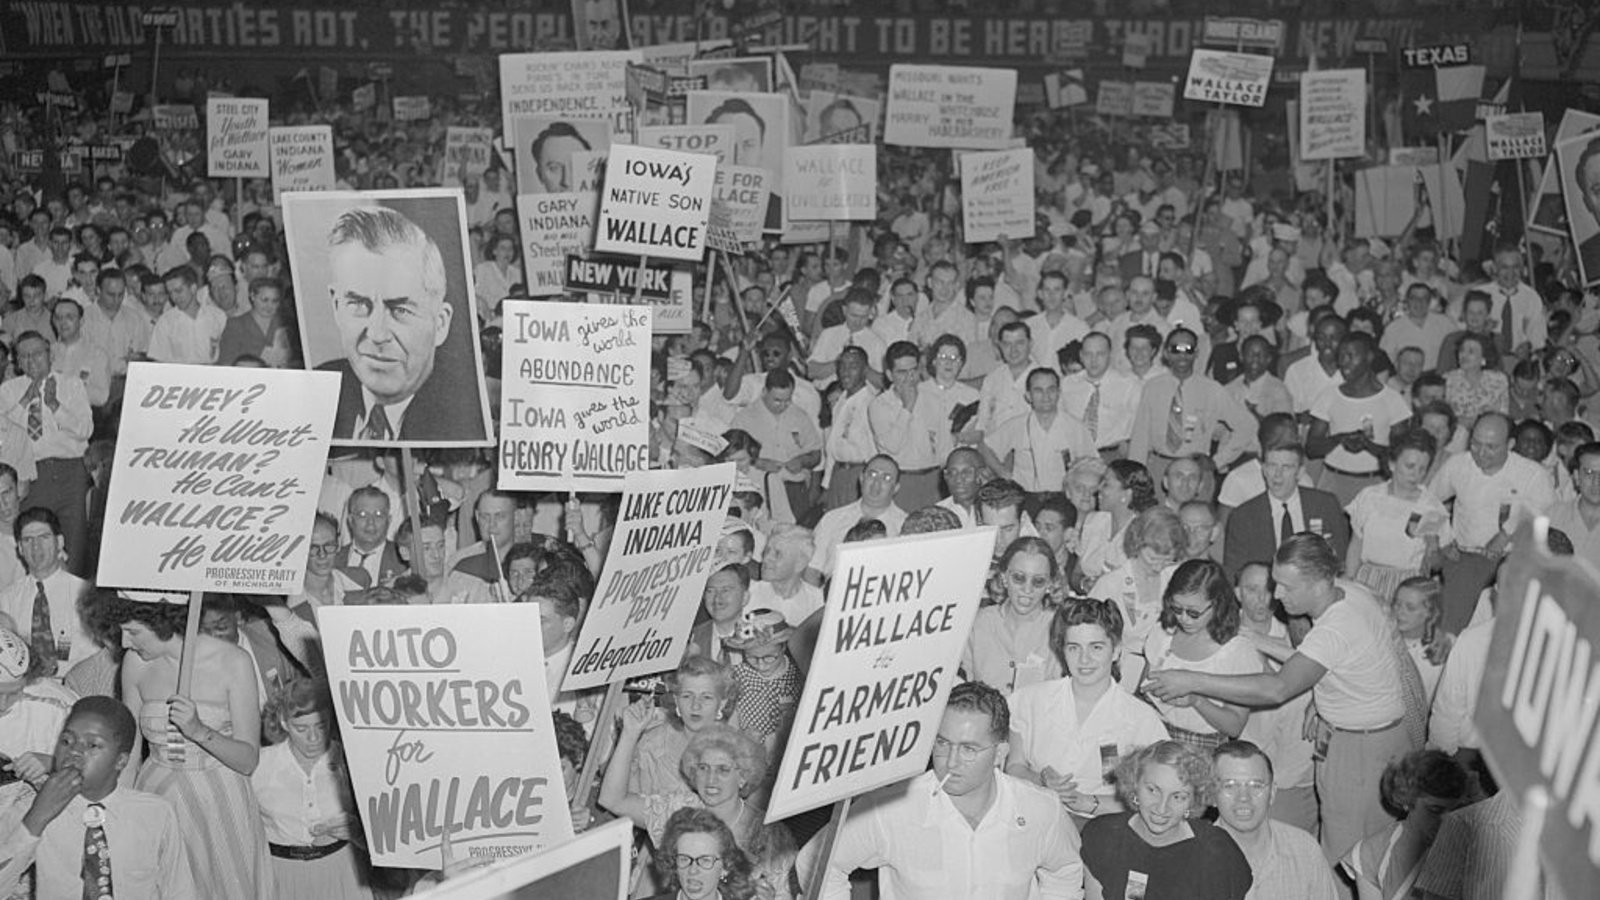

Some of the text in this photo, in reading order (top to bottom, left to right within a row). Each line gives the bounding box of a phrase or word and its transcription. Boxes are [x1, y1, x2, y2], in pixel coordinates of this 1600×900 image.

[150, 2, 280, 46] ARTIES
[467, 12, 568, 49] PEOPL
[632, 14, 693, 47] AVE
[875, 18, 916, 53] TO
[930, 18, 972, 54] BE
[1404, 45, 1468, 66] TEXAS
[1190, 77, 1263, 94] WALLACE
[1204, 89, 1262, 104] TAYLOR
[223, 149, 254, 160] GARY
[276, 144, 326, 157] INDIANA
[658, 134, 720, 151] STOP
[1490, 138, 1545, 149] WALLACE
[213, 160, 261, 172] INDIANA
[731, 172, 763, 188] FOR
[795, 158, 867, 175] WALLACE
[537, 198, 580, 215] GARY
[609, 187, 703, 212] NATIVE SON
[717, 187, 761, 206] LACE
[529, 214, 592, 232] INDIANA
[571, 260, 670, 292] NEW YORK
[577, 316, 619, 347] gives
[621, 308, 648, 327] the
[593, 333, 637, 354] world
[519, 358, 635, 386] ABUNDANCE
[140, 383, 267, 414] DEWEY?
[573, 401, 608, 430] gives
[612, 395, 640, 412] the
[177, 414, 220, 444] He
[592, 408, 643, 435] world
[128, 447, 281, 475] TRUMAN?
[502, 438, 648, 473] HENRY WALLACE
[170, 470, 212, 496] He
[623, 483, 731, 522] LAKE COUNTY
[119, 500, 290, 534] WALLACE?
[622, 519, 704, 557] INDIANA
[157, 532, 306, 574] He Will!
[205, 567, 297, 582] PROGRESSIVE PARTY
[214, 579, 283, 589] OF MICHIGAN
[840, 564, 934, 613] HENRY
[835, 602, 958, 655] WALLACE
[347, 626, 458, 669] AUTO
[571, 627, 674, 684] delegation
[339, 678, 531, 729] WORKERS
[807, 665, 945, 736] FARMERS
[384, 729, 435, 787] for
[791, 719, 923, 792] FRIEND
[368, 775, 549, 857] WALLACE
